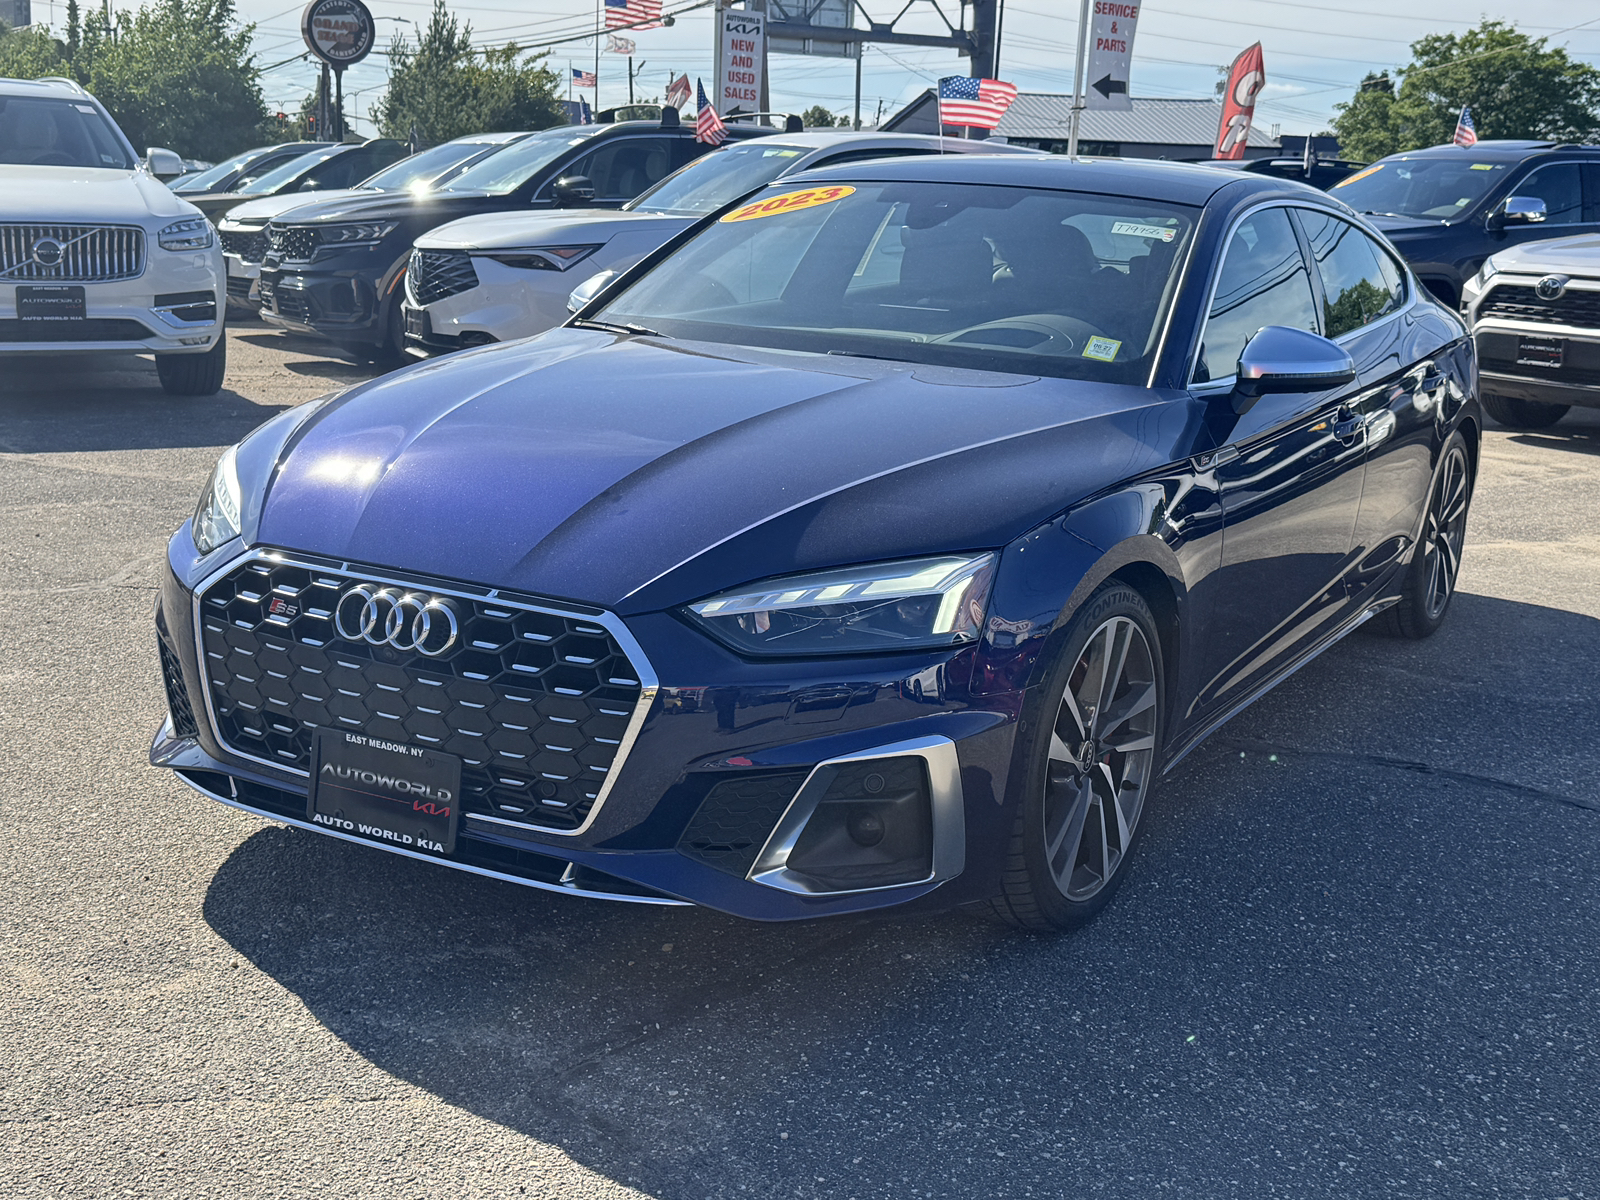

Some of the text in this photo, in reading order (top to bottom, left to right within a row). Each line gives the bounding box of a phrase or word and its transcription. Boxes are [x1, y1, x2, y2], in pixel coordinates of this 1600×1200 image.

[1094, 1, 1138, 19] SERVICE
[726, 14, 760, 25] AUTOWORLD
[1110, 21, 1118, 34] &
[726, 22, 760, 36] KIA
[731, 38, 755, 53] NEW
[1096, 38, 1127, 53] PARTS
[731, 55, 753, 69] AND
[728, 71, 755, 85] USED
[724, 86, 757, 102] SALES
[732, 187, 843, 220] 2023
[274, 600, 298, 616] S5
[345, 733, 367, 746] EAST
[411, 747, 424, 758] NY
[320, 762, 452, 802] AUTOWORLD
[413, 800, 451, 818] KIA
[312, 813, 445, 853] AUTO WORLD KIA
